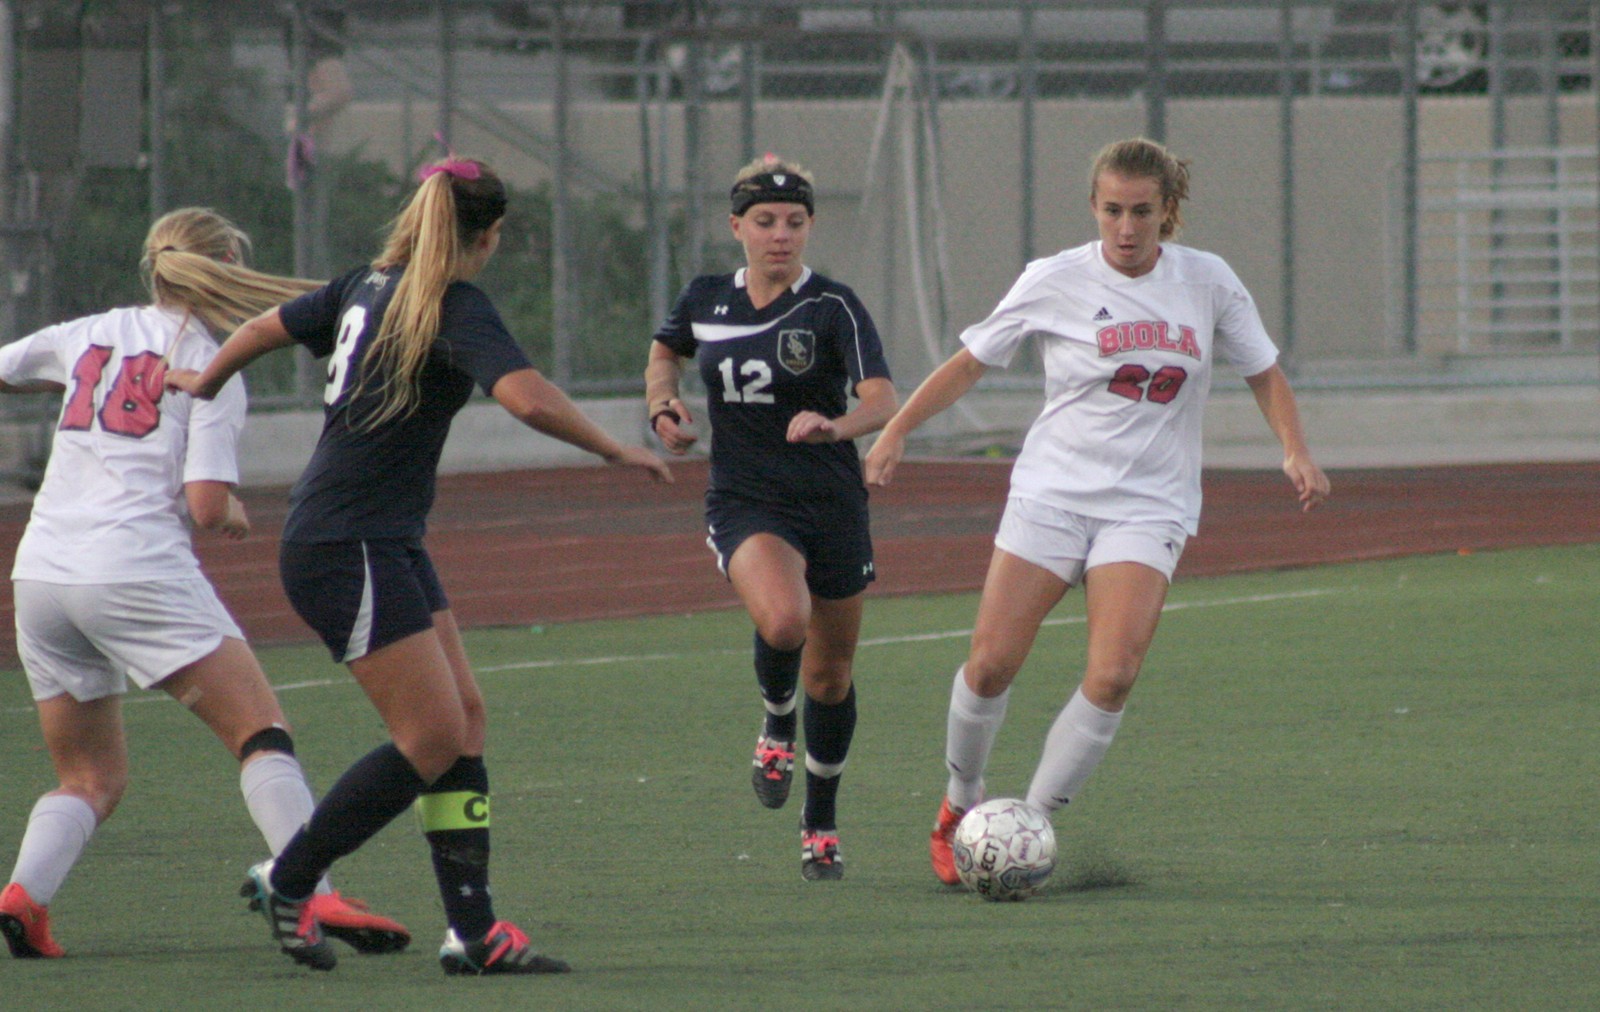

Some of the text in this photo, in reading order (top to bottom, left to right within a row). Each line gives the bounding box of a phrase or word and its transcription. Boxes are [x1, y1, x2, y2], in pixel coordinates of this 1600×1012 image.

[1096, 320, 1201, 362] BIOLA
[58, 343, 169, 439] 18
[718, 357, 775, 404] 12
[1107, 363, 1188, 404] 20
[463, 796, 488, 822] C
